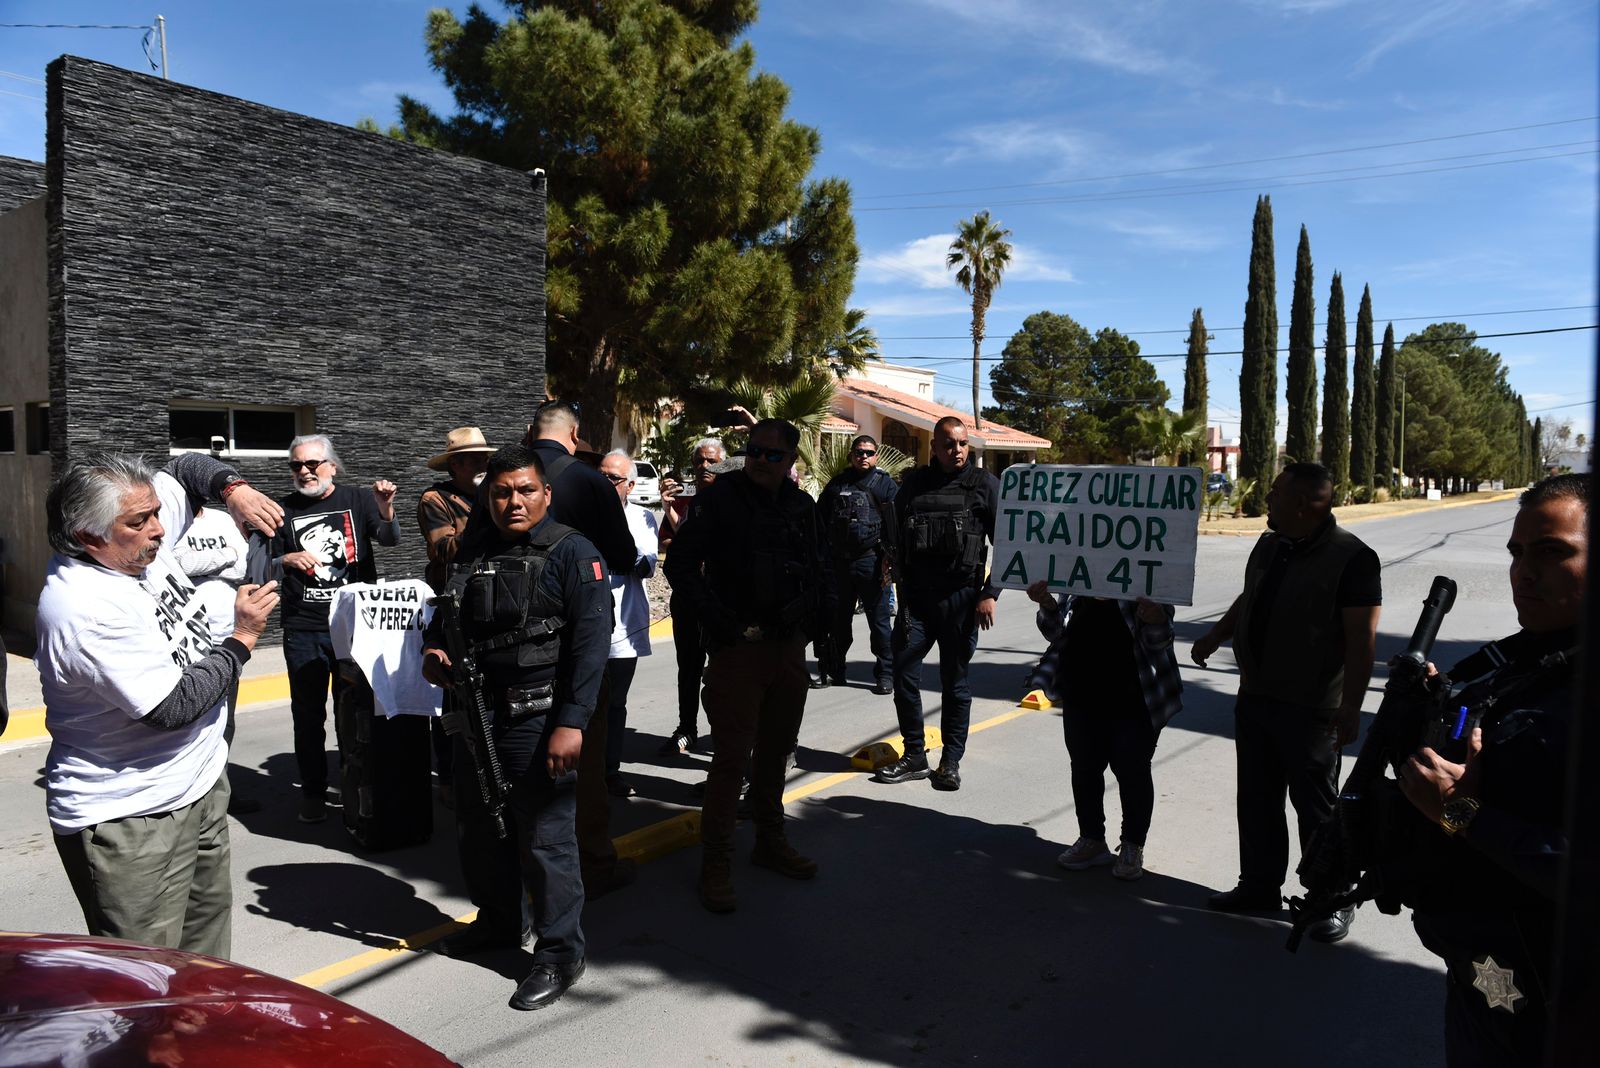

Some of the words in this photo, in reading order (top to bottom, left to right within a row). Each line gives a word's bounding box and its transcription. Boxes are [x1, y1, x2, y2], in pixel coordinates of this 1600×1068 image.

[1088, 472, 1197, 511] CUELLAR
[1003, 509, 1167, 552] TRAIDOR
[1001, 550, 1028, 585] A
[1047, 554, 1092, 590] LA
[1106, 557, 1163, 596] 4T
[380, 607, 414, 631] PEREZ
